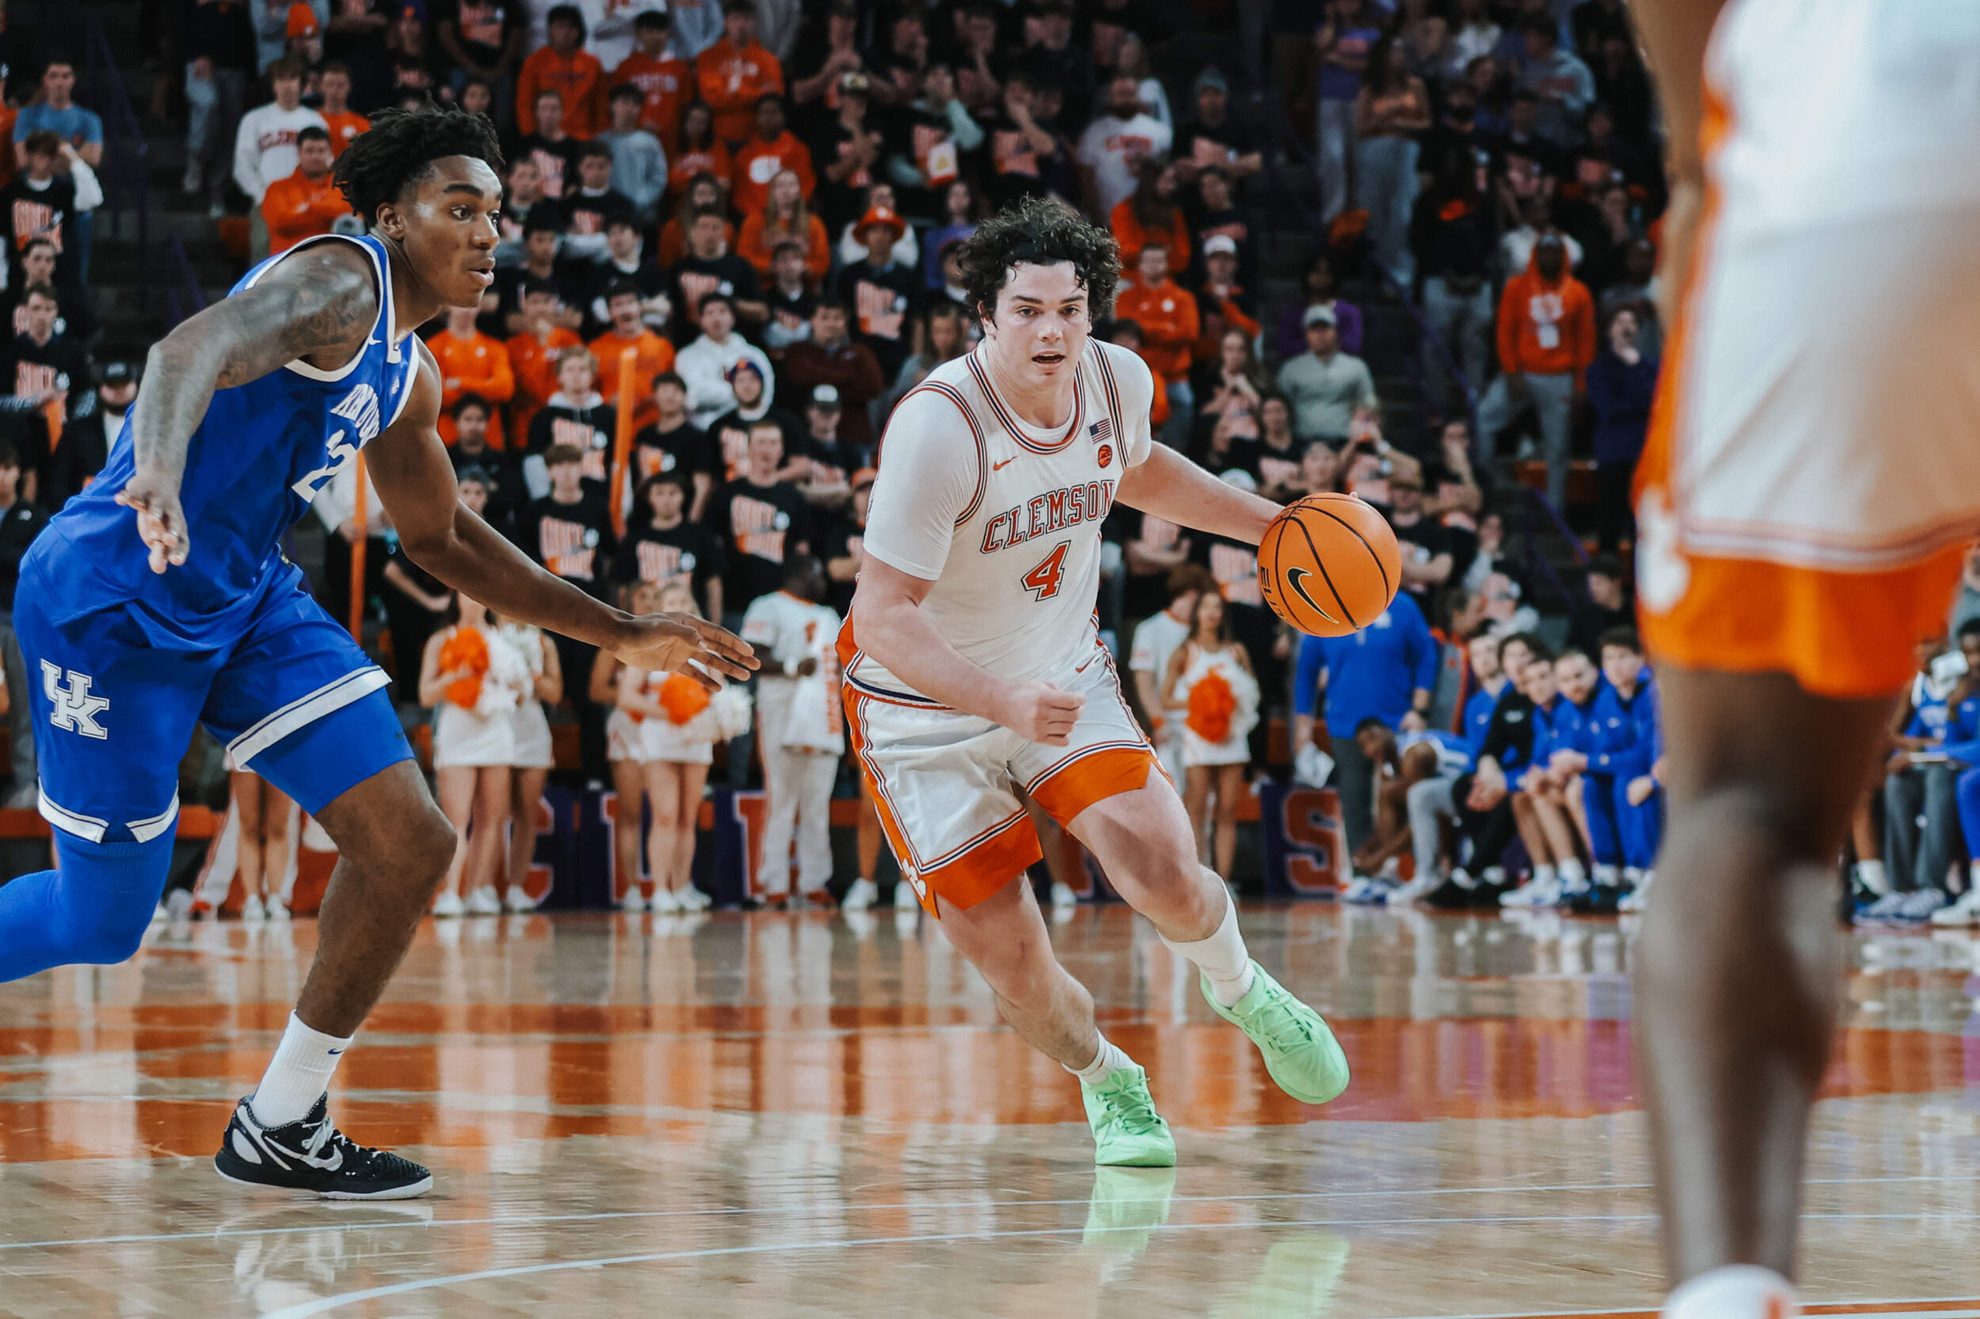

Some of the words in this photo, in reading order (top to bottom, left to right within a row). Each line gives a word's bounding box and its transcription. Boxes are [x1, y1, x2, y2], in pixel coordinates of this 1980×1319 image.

[980, 479, 1115, 554] CLEMSON
[1020, 540, 1072, 602] 4
[40, 658, 110, 740] UK
